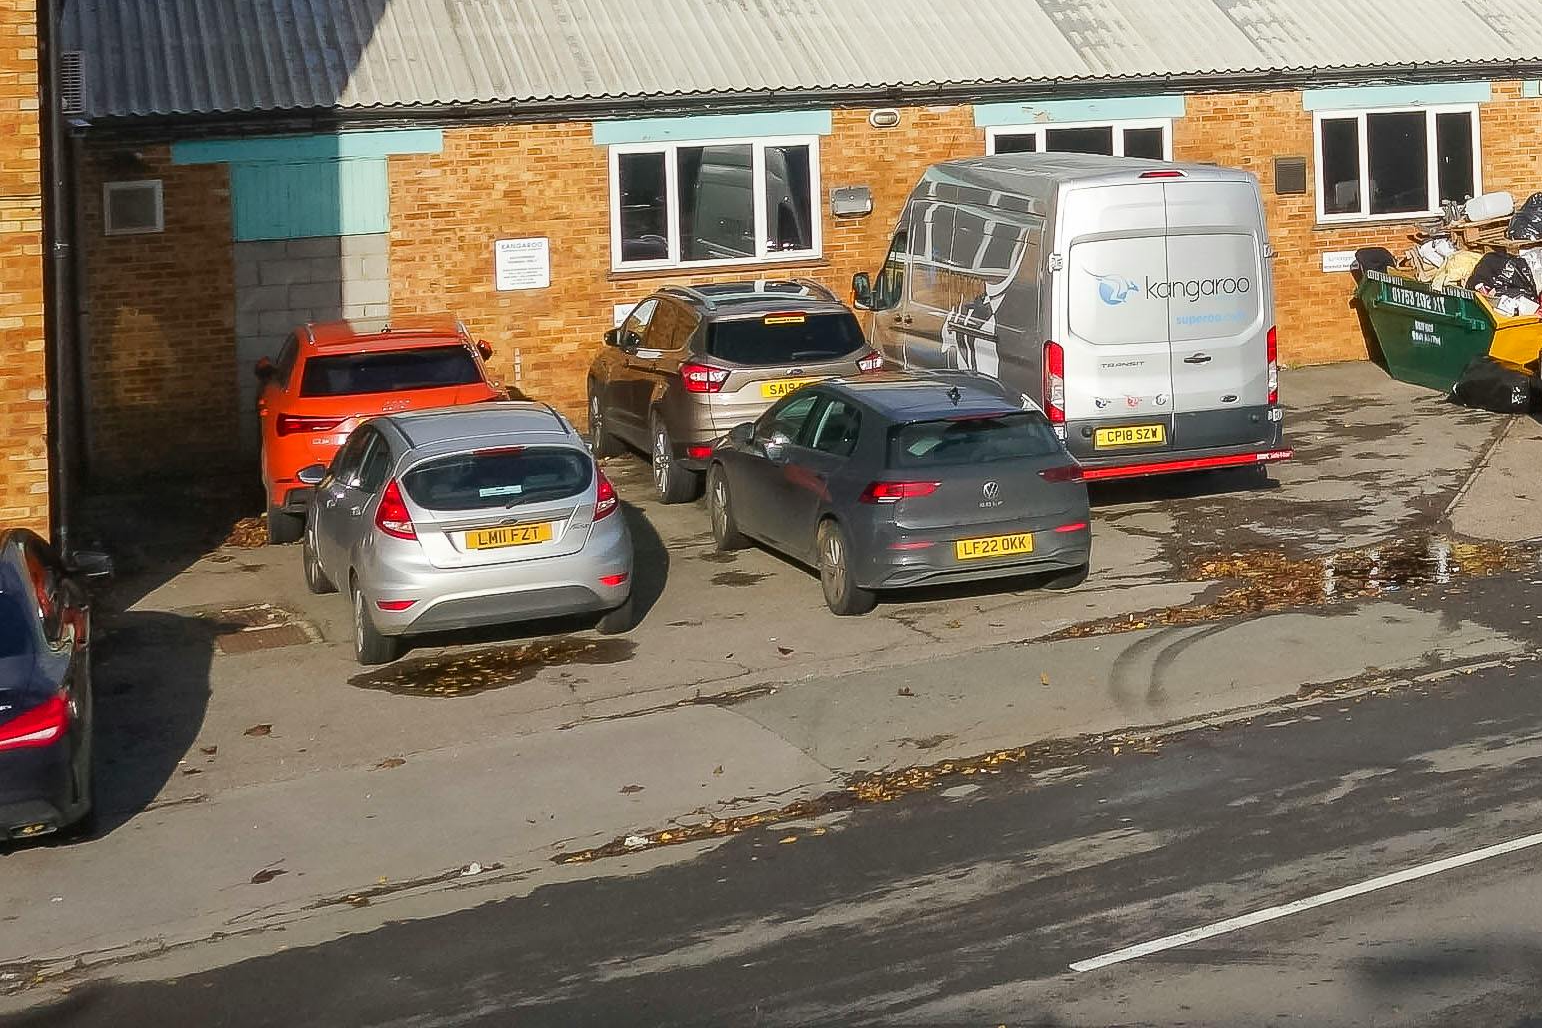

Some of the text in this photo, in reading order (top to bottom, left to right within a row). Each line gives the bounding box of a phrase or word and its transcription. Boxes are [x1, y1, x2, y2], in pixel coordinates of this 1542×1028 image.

[501, 241, 543, 250] KANGAROO
[1145, 275, 1250, 303] kangaroo
[1101, 360, 1145, 369] TRANSIT
[1107, 427, 1158, 442] CP18 SZW
[477, 526, 540, 546] LM11 FZT
[963, 535, 1027, 556] LF22 OKK
